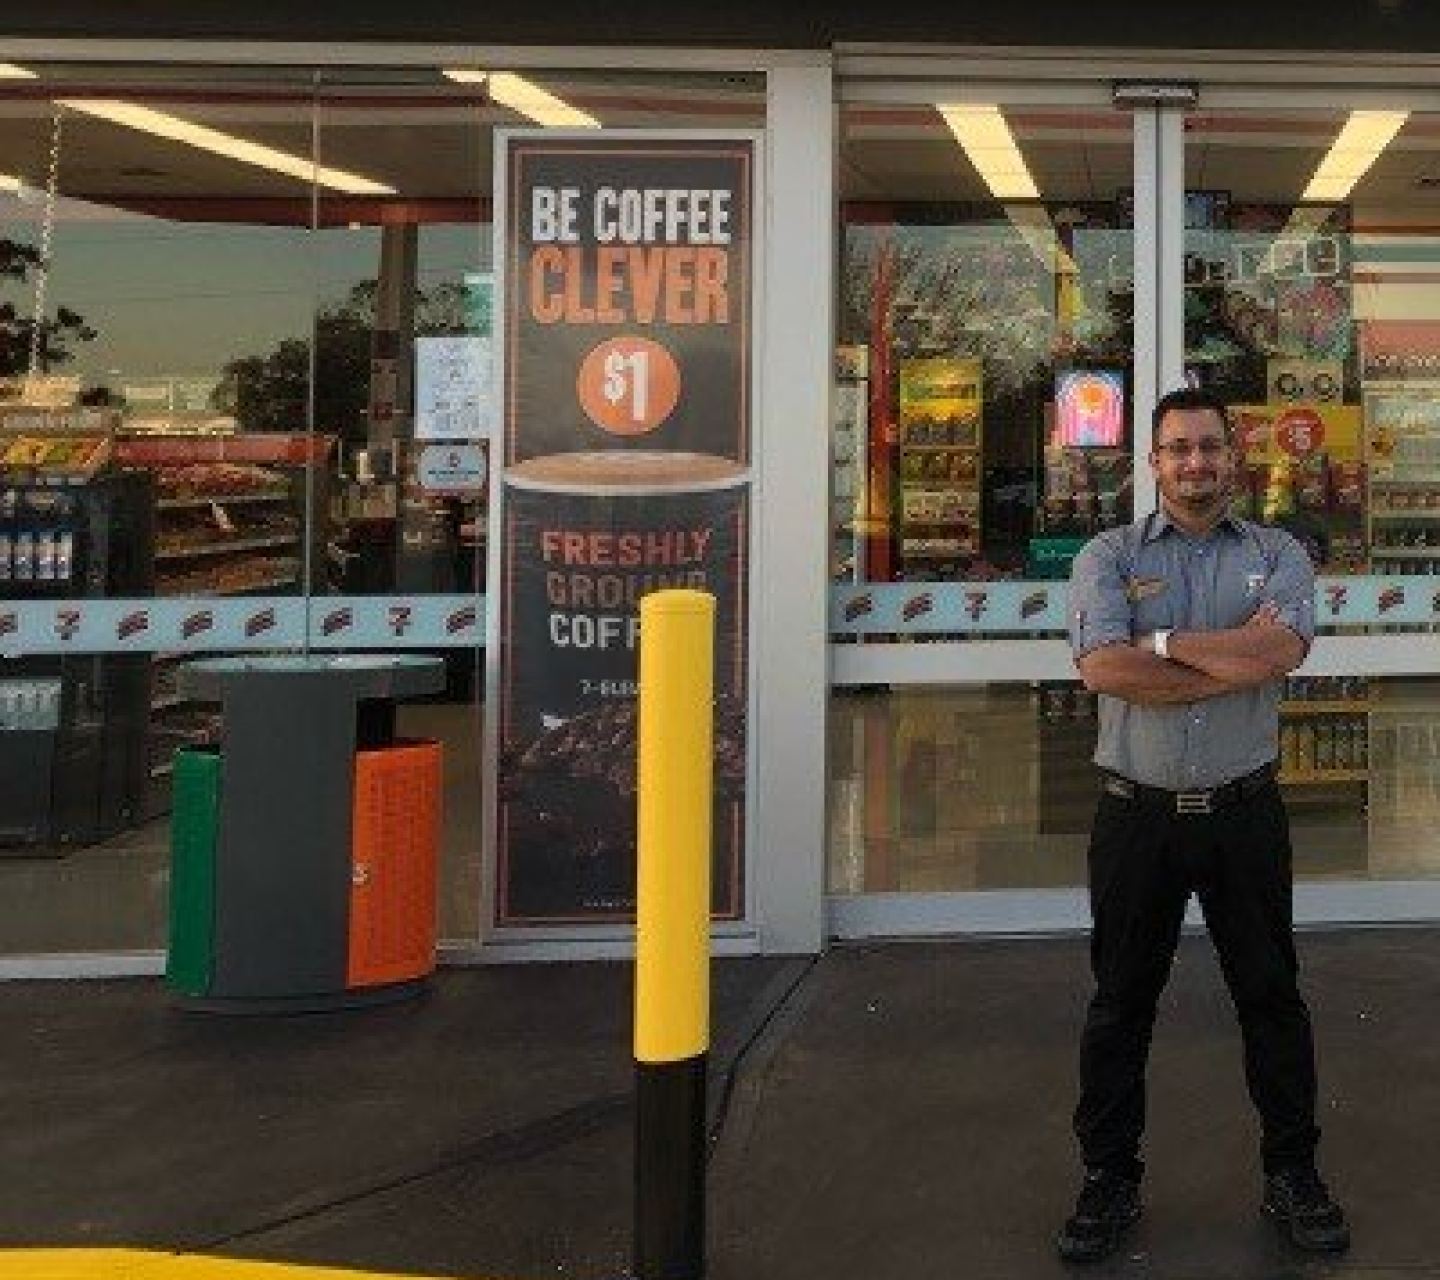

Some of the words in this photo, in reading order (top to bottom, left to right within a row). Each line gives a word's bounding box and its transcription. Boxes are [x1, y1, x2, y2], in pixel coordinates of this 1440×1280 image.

[532, 186, 580, 241] BE
[594, 187, 731, 244] COFFEE
[530, 247, 731, 324] CLEVER
[604, 348, 649, 421] $1
[543, 527, 713, 565] FRESHLY
